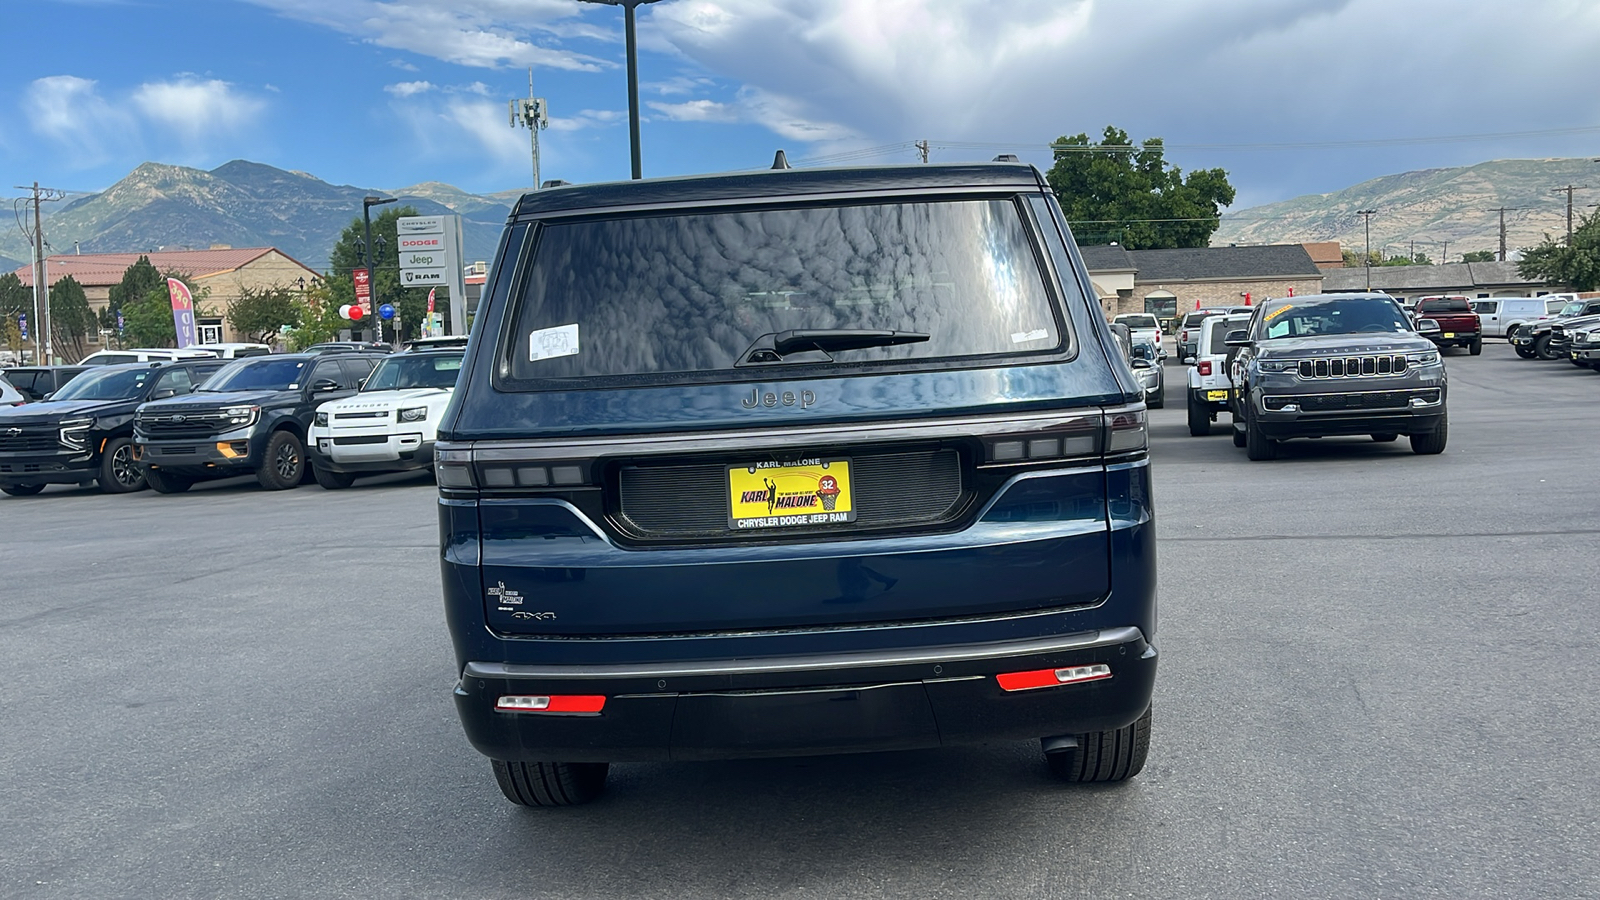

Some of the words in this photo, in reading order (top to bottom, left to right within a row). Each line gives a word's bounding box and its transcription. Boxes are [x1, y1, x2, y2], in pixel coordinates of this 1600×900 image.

[410, 255, 433, 265] Jeep
[1312, 346, 1392, 354] WAGONEER
[741, 388, 816, 409] Jeep
[756, 460, 781, 469] KARL
[783, 458, 821, 467] MALONE
[822, 480, 834, 490] 32
[740, 490, 768, 503] KARL
[775, 495, 817, 509] MALONE
[737, 518, 779, 528] CHRYSLER
[780, 515, 808, 525] DODGE
[808, 514, 828, 523] JEEP
[830, 512, 848, 522] RAM
